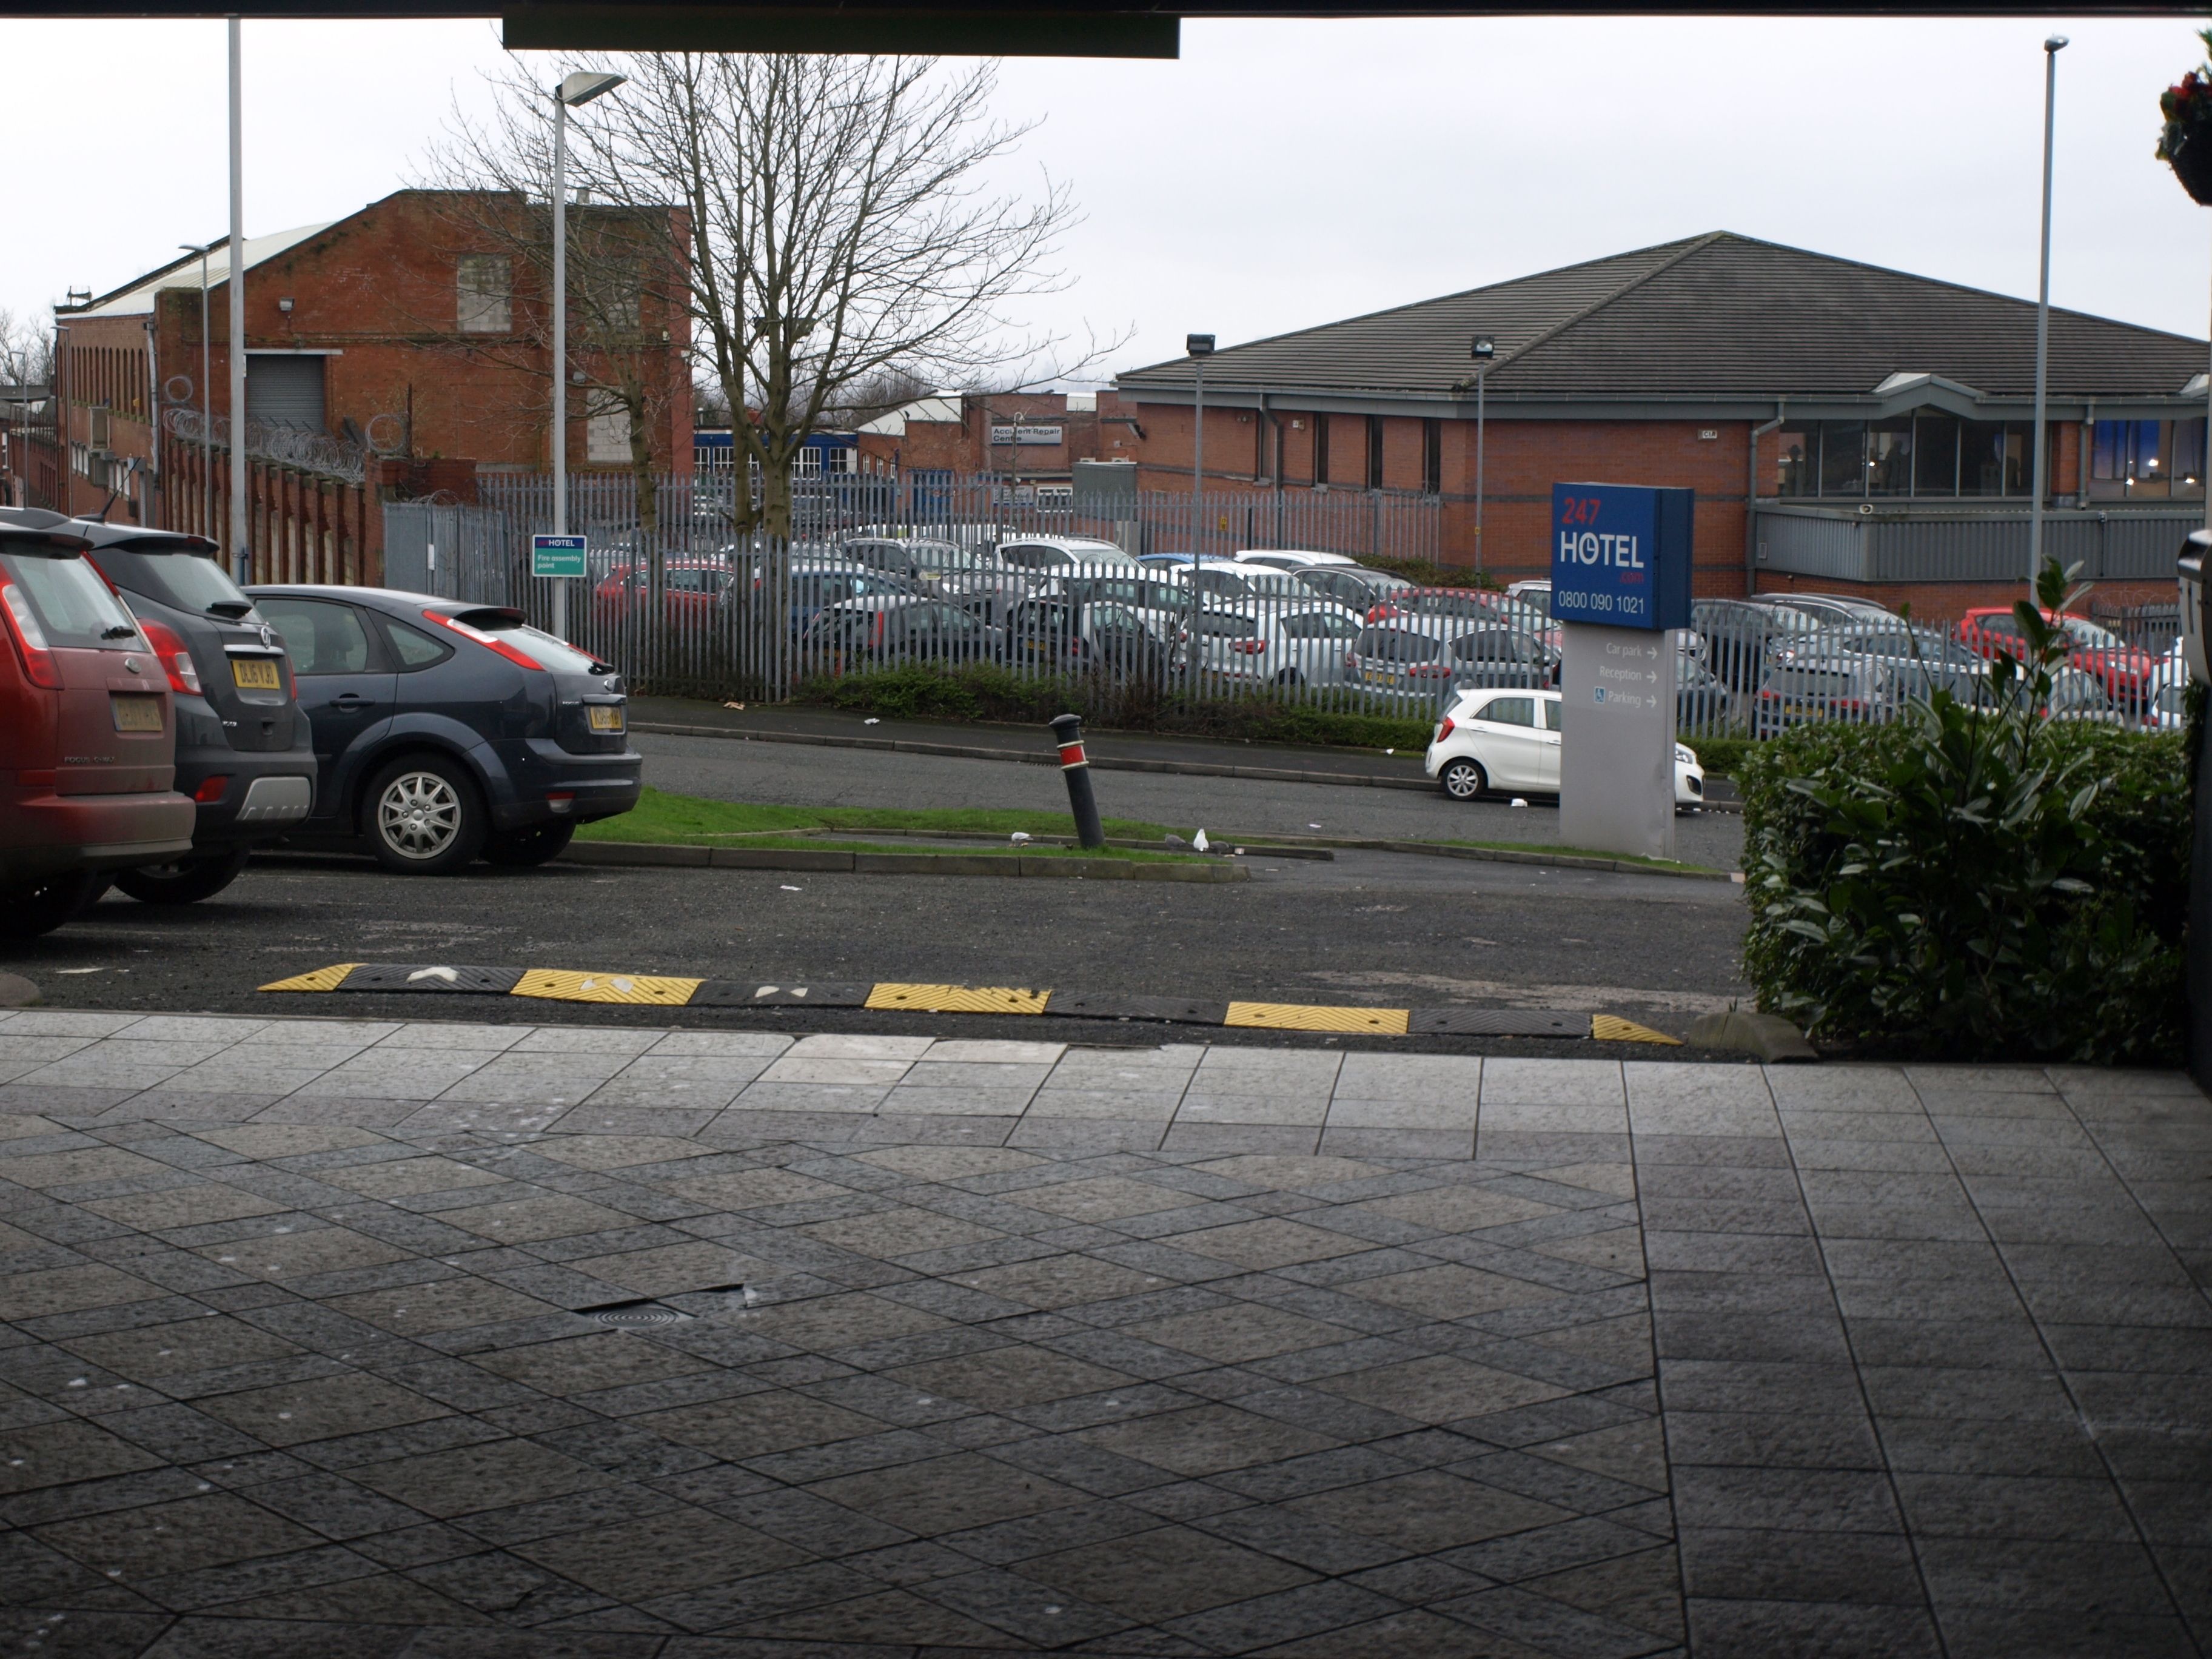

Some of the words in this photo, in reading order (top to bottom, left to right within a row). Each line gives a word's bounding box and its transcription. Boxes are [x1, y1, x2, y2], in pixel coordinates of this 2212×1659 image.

[1562, 498, 1601, 525] 247
[1560, 531, 1644, 568] HOTEL
[551, 555, 581, 563] assembly
[1558, 590, 1587, 609] 0800
[1590, 593, 1613, 611] 090
[1616, 595, 1644, 614] 1021
[1606, 643, 1621, 654] Car
[1622, 645, 1642, 659] park
[1600, 666, 1641, 682] Reception
[1608, 691, 1641, 708] Parking
